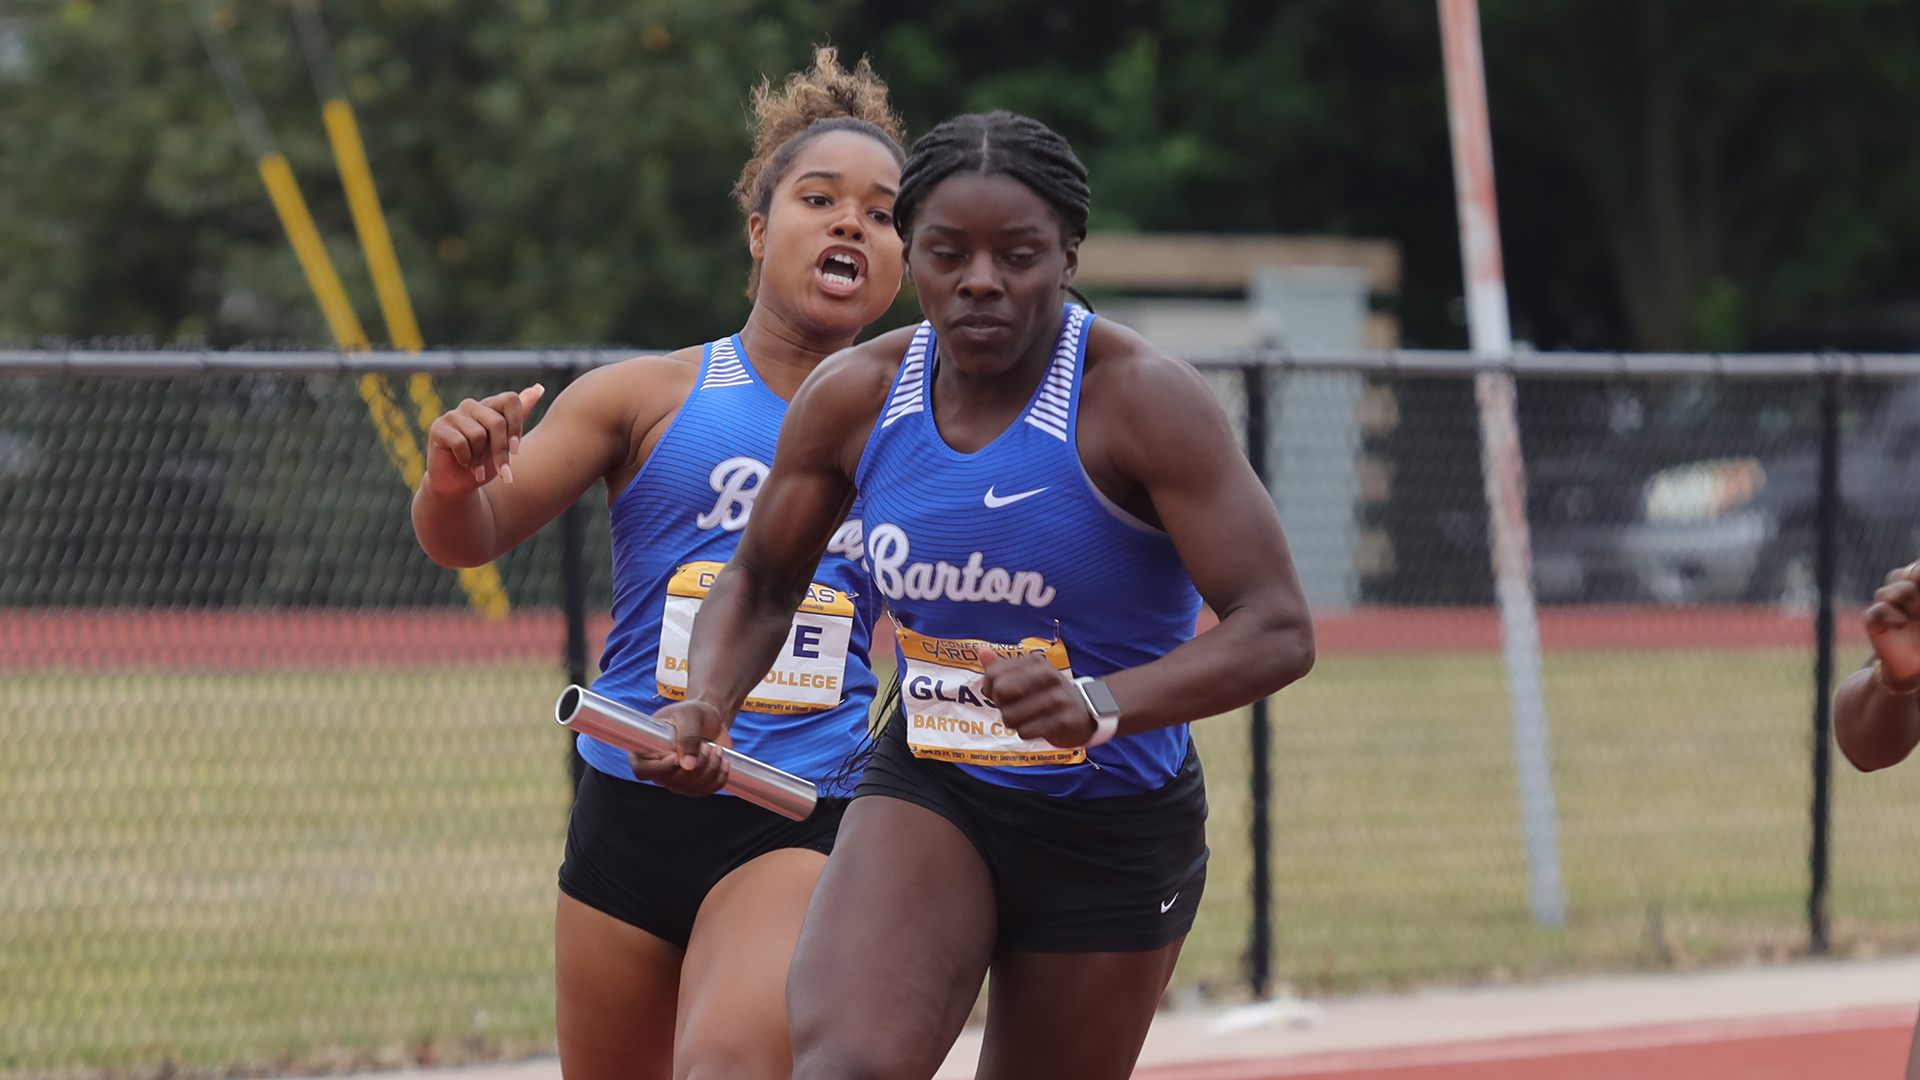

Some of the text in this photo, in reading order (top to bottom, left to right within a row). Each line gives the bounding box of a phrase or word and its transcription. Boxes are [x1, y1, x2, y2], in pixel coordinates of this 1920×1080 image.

[867, 522, 1056, 608] Barton
[762, 669, 838, 690] OLLEGE
[755, 701, 784, 711] University
[913, 714, 984, 736] BARTON
[1000, 754, 1028, 762] University
